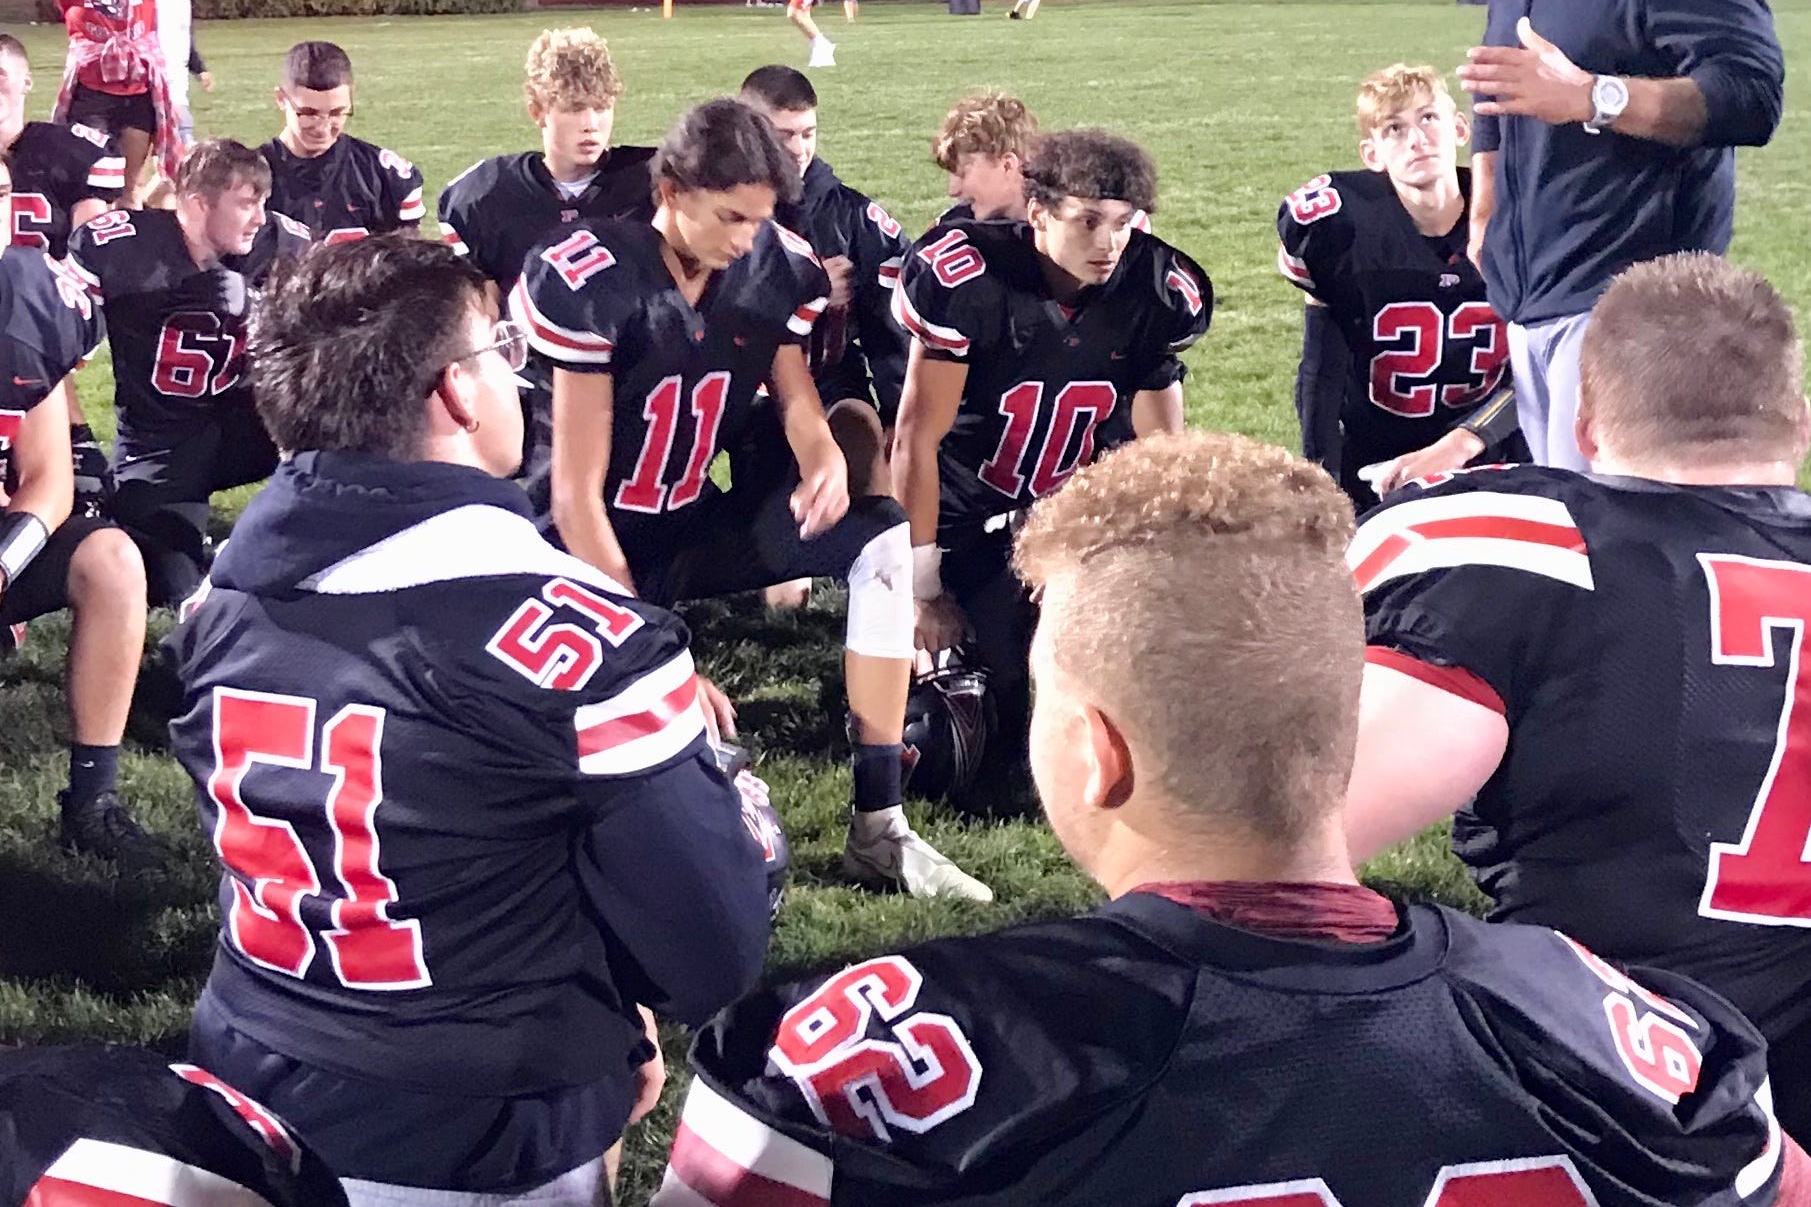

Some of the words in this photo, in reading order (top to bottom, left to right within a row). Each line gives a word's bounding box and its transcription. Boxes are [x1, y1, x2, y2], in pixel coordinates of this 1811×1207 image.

[540, 230, 617, 291] 11
[917, 229, 986, 289] 10
[1369, 301, 1510, 418] 23
[613, 370, 732, 514] 11
[977, 381, 1118, 500] 10
[486, 576, 644, 691] 51
[208, 687, 433, 991] 51
